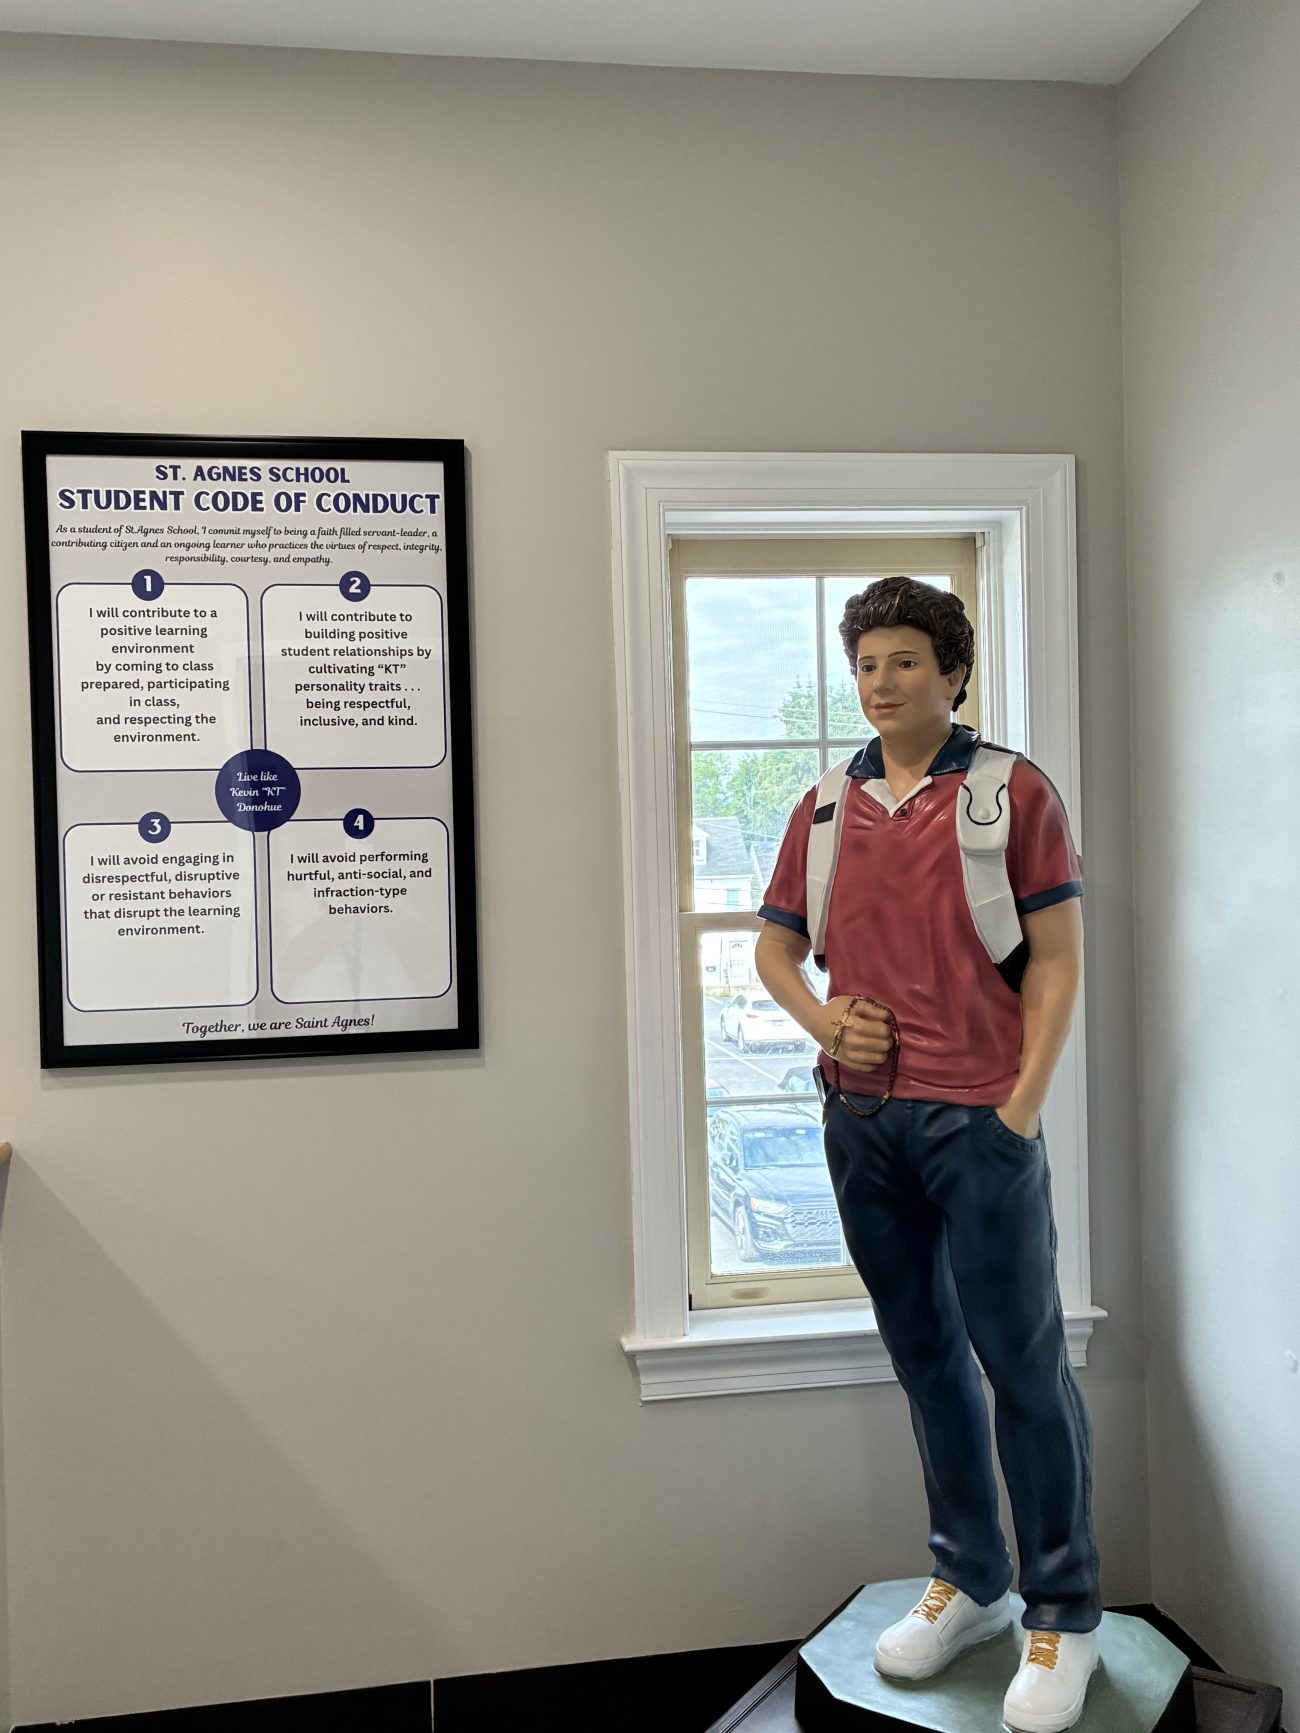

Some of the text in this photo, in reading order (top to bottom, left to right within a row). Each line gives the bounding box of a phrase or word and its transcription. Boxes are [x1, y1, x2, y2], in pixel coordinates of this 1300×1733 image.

[155, 464, 350, 483] ST. AGNES SCHOOL
[58, 489, 440, 514] STUDENT CODE OF CONDUCT
[55, 524, 68, 533] As
[78, 524, 112, 534] student
[113, 524, 124, 537] of
[167, 525, 200, 535] School,
[201, 526, 207, 535] I
[208, 527, 241, 535] commit
[242, 526, 273, 537] myself
[284, 526, 308, 539] being
[316, 526, 338, 539] faith
[338, 527, 361, 540] filled
[363, 528, 430, 538] servant-leader,
[51, 538, 108, 551] contributing
[109, 539, 139, 551] citizen
[140, 539, 159, 548] and
[174, 542, 211, 552] ongoing
[213, 539, 246, 549] learner
[247, 540, 267, 549] who
[268, 542, 308, 552] practices
[310, 540, 324, 550] the
[326, 542, 356, 550] virtues
[357, 541, 368, 554] of
[368, 543, 402, 554] respect,
[403, 542, 442, 554] integrity,
[165, 553, 333, 567] responsibility, courtesy, and empathy.
[144, 575, 152, 592] 1
[349, 577, 361, 593] 2
[89, 607, 218, 618] I will contribute to a
[299, 611, 412, 622] I will contribute to
[100, 625, 208, 638] positive learning
[305, 628, 408, 642] building positive
[112, 643, 194, 654] environment
[281, 646, 432, 659] student relationships by
[96, 660, 214, 674] by coming to class
[308, 663, 375, 677] cultivating
[81, 678, 230, 692] prepared, participating
[295, 681, 366, 694] personality
[368, 681, 402, 691] traits
[129, 696, 180, 709] in class,
[306, 698, 411, 711] being respectful,
[96, 713, 216, 727] and respecting the
[300, 715, 417, 728] inclusive, and kind.
[113, 732, 200, 743] environment.
[236, 771, 278, 782] Live like
[229, 787, 259, 797] Kevin
[236, 801, 282, 812] Donohue
[148, 819, 161, 835] 3
[354, 814, 364, 830] 4
[91, 852, 234, 867] I will avoid engaging in
[291, 851, 429, 865] I will avoid performing
[82, 870, 240, 886] disrespectful, disruptive
[287, 867, 432, 882] hurtful, anti-social, and
[92, 888, 232, 902] or resistant behaviors
[314, 886, 407, 899] infraction-type
[83, 905, 240, 920] that disrupt the learning
[329, 903, 393, 915] behaviors.
[118, 924, 204, 936] environment.
[182, 1014, 375, 1038] Together, we are Saint Agnes!
